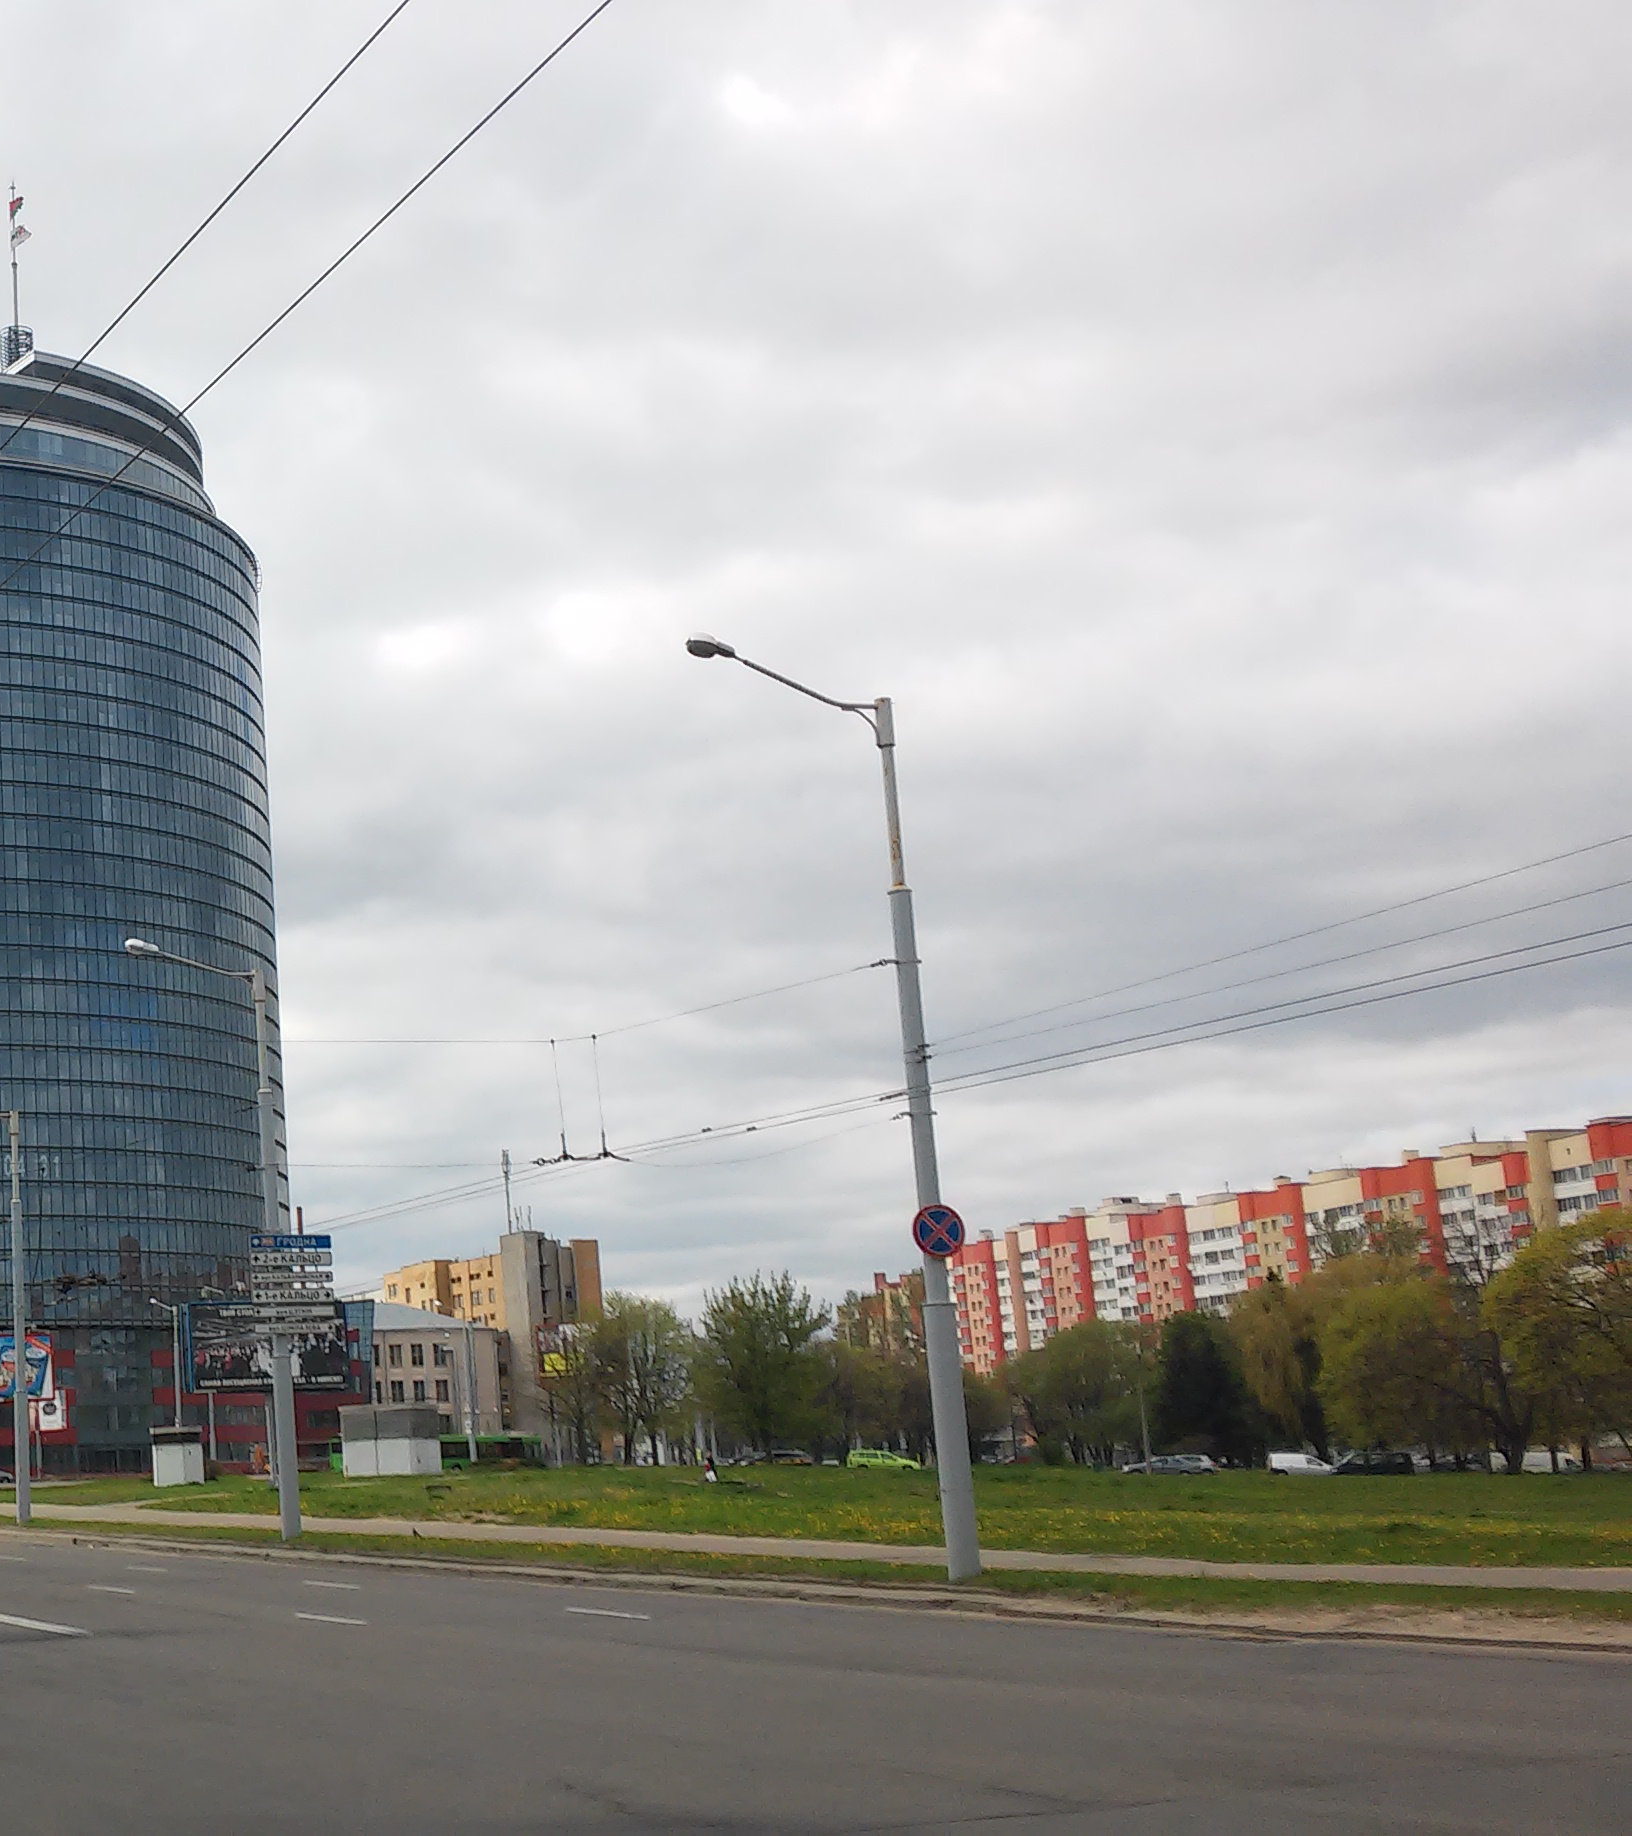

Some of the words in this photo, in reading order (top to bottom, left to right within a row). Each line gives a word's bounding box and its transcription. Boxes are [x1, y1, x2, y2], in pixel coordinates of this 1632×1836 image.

[276, 1236, 317, 1247] ГРОДНА
[263, 1253, 279, 1264] 2-е
[280, 1254, 322, 1265] КАЛЬЦО
[279, 1290, 320, 1301] КАЛЬЦО
